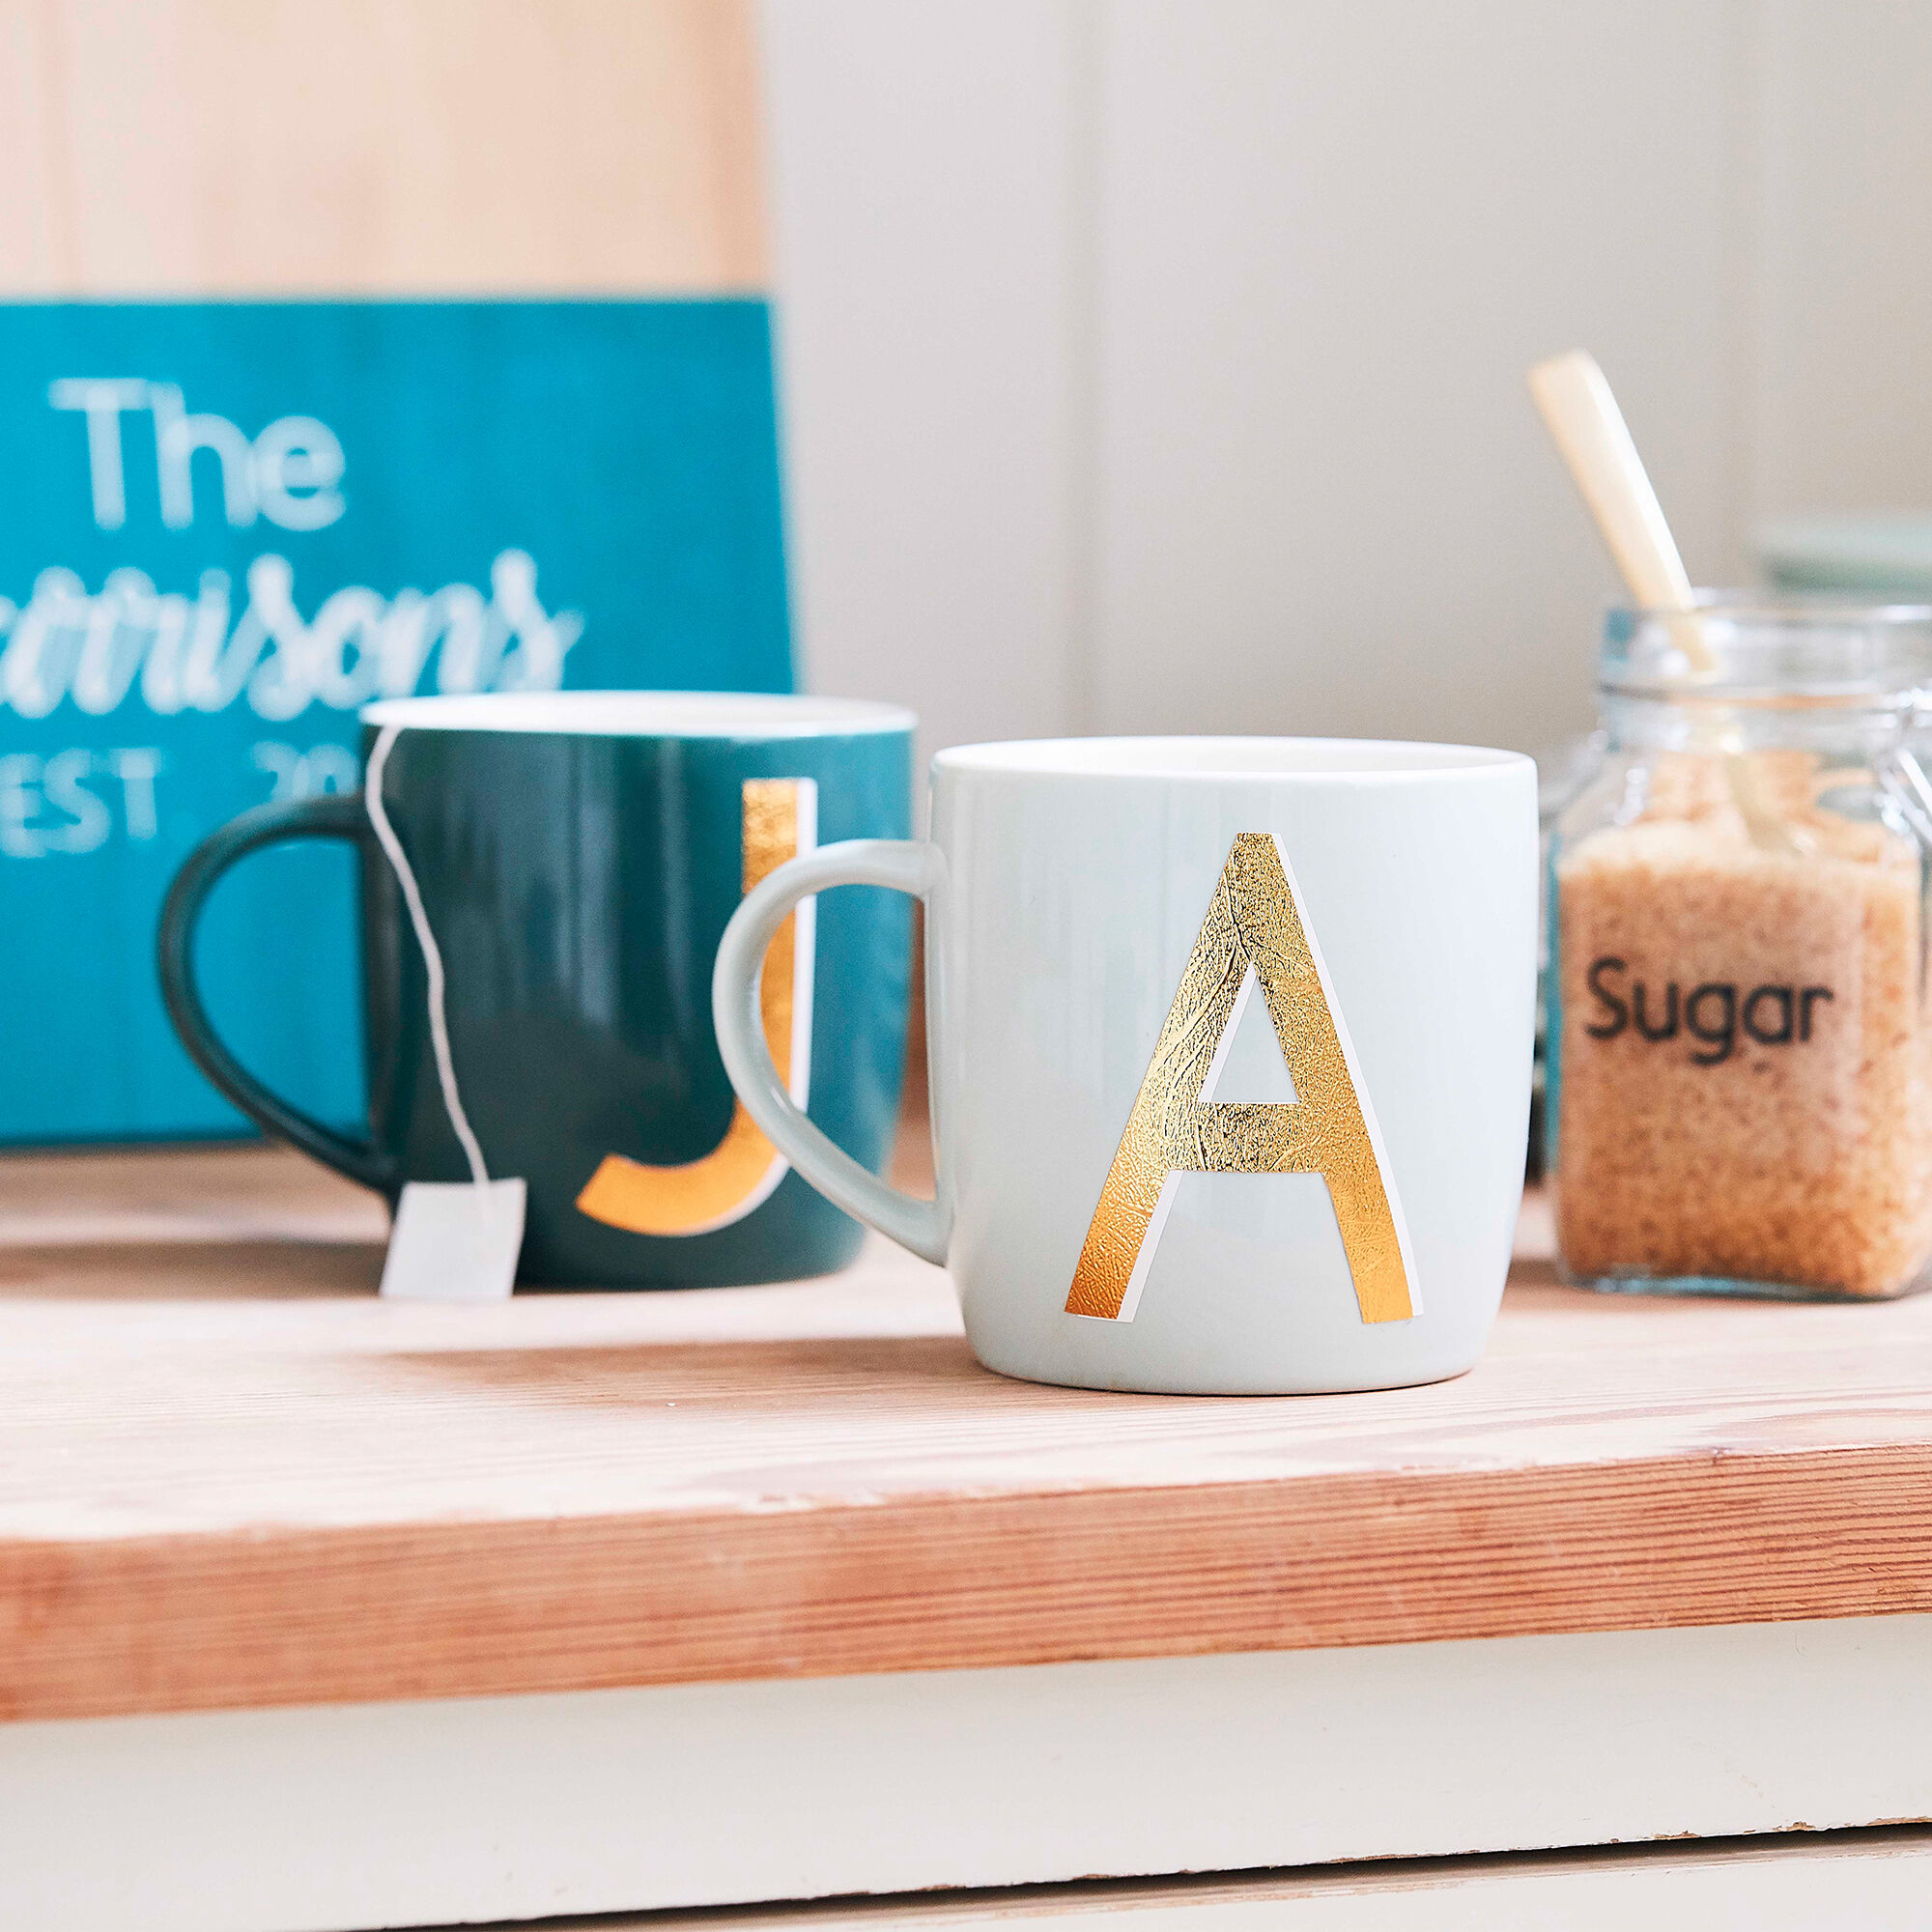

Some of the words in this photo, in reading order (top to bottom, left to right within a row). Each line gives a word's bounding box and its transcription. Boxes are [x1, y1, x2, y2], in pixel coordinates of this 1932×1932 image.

[48, 378, 346, 530] The
[0, 548, 583, 720] rrisons
[577, 778, 817, 1236] J
[1065, 832, 1424, 1323] A
[1585, 956, 1834, 1065] Sugar
